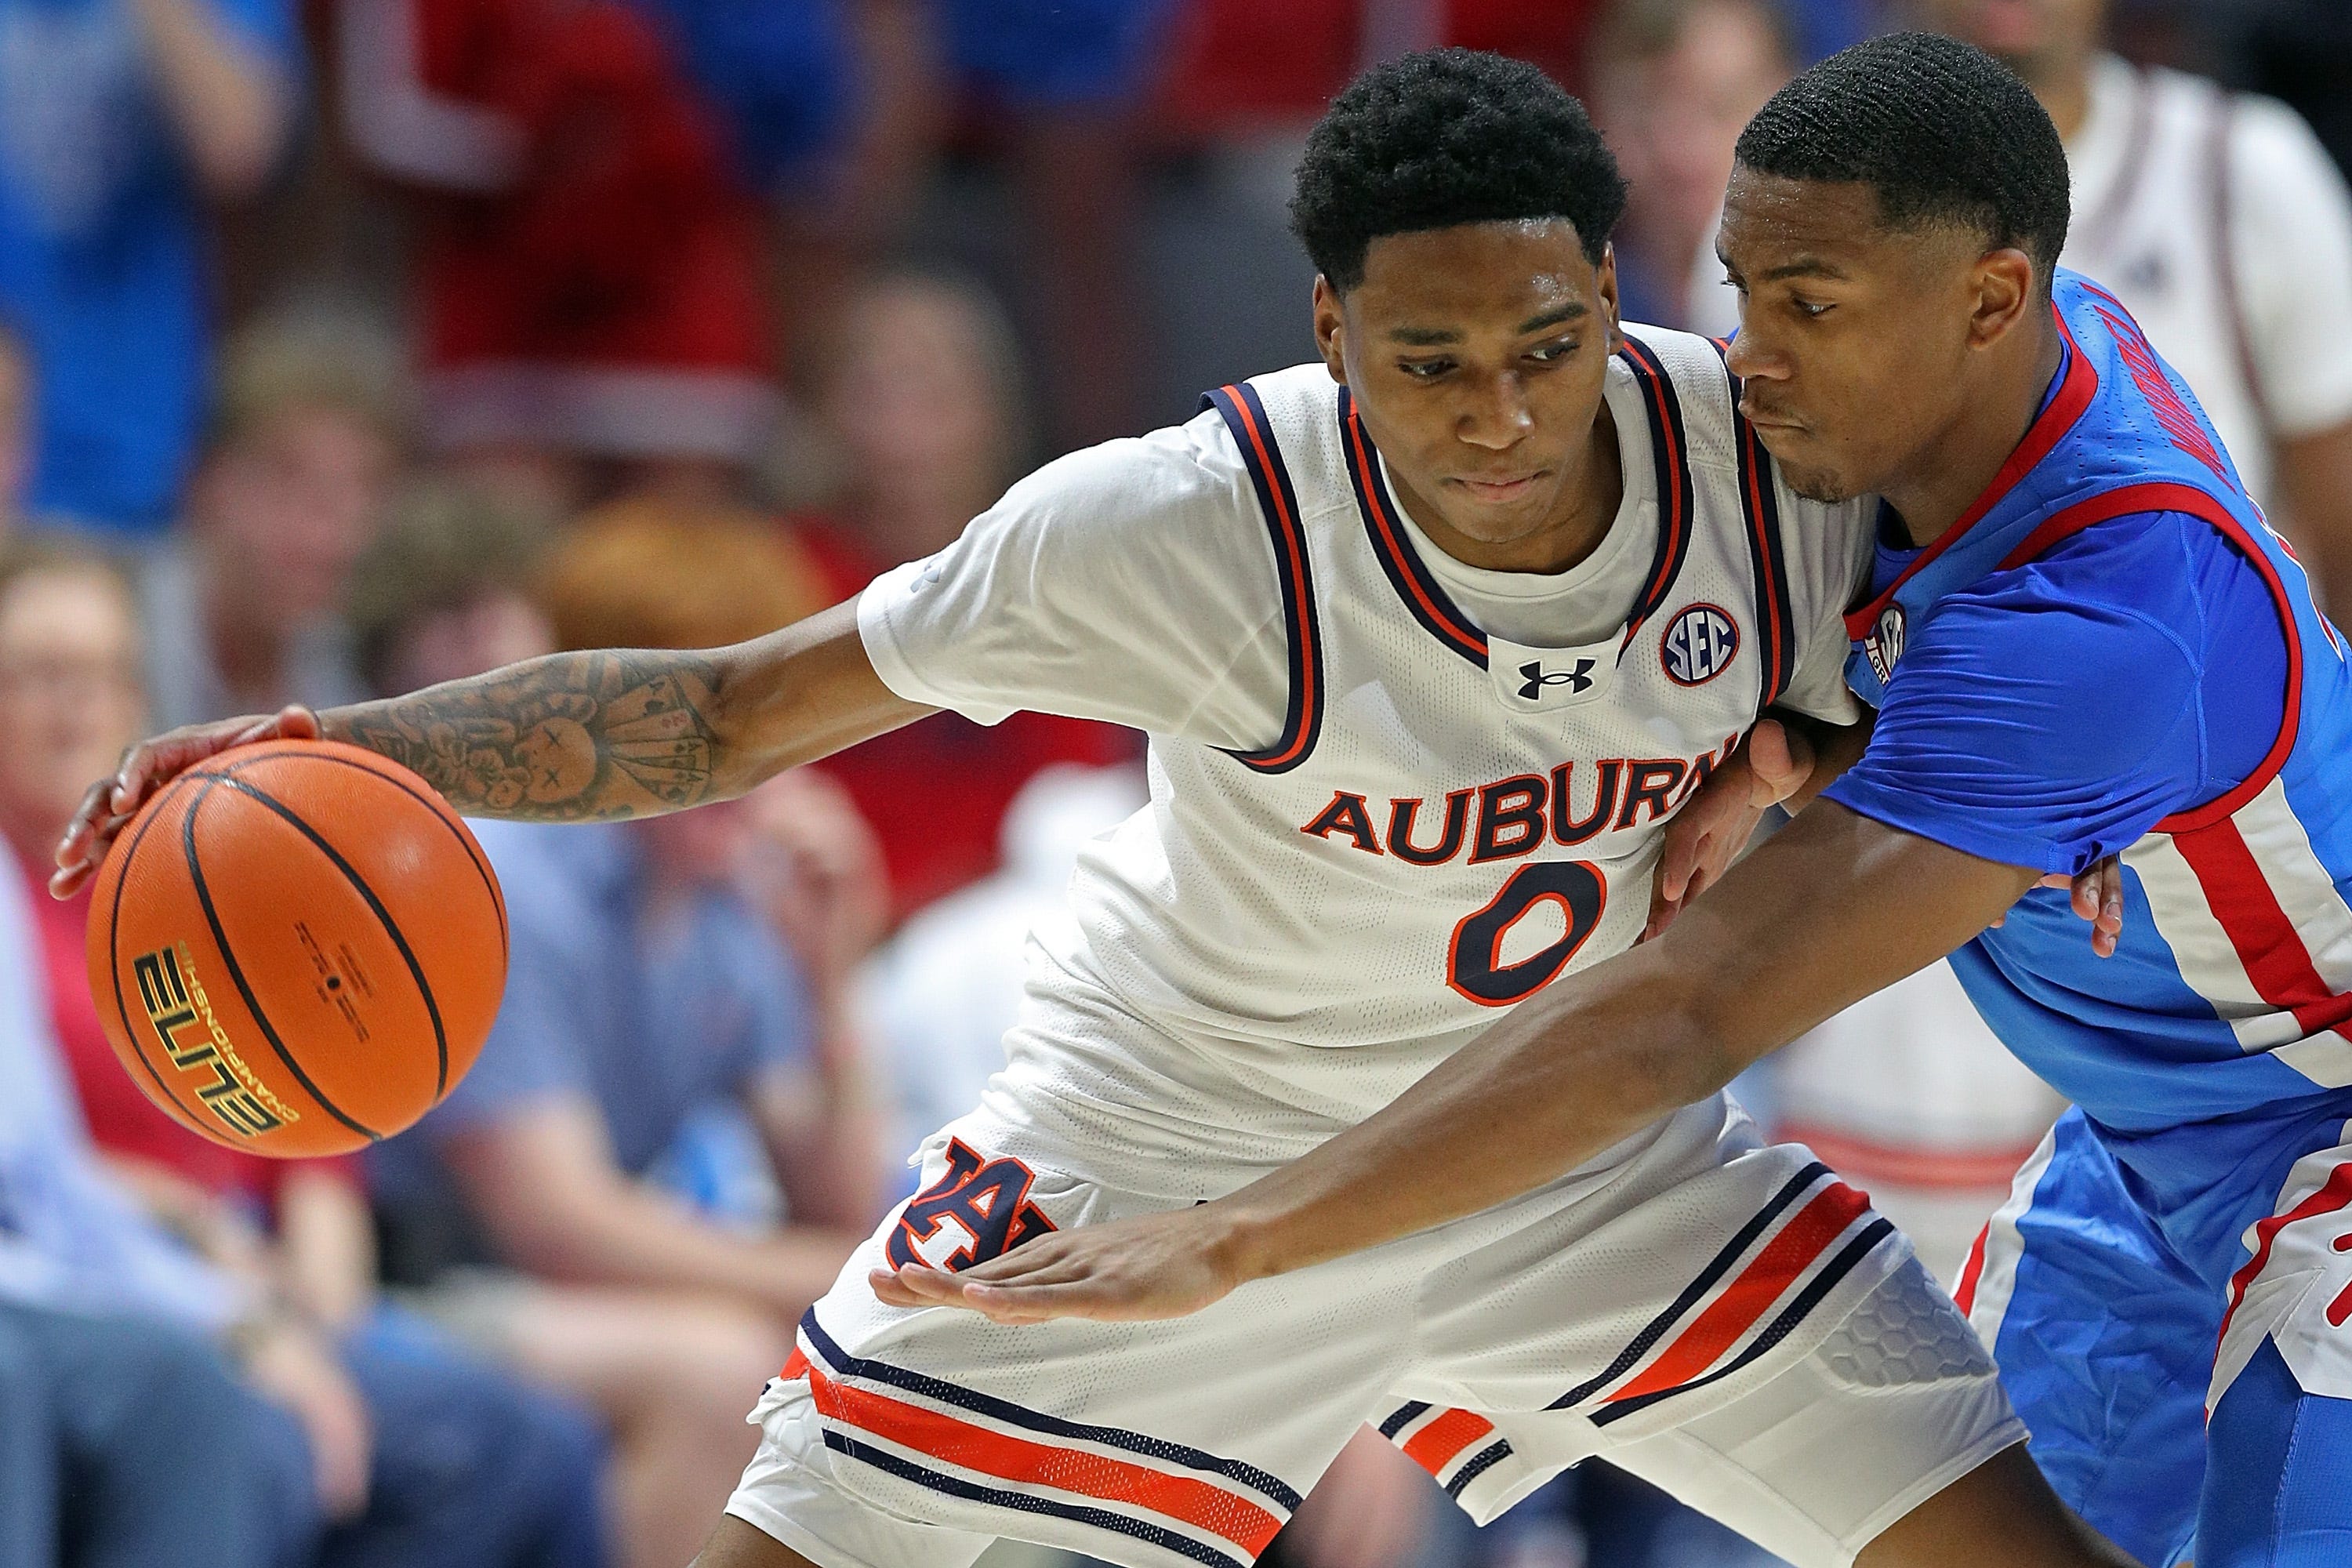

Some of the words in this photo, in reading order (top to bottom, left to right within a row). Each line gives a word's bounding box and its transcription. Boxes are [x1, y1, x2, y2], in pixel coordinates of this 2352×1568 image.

[1666, 611, 1732, 681] SEC
[1446, 860, 1607, 1008] 0
[132, 946, 285, 1138] ELITE
[177, 939, 302, 1123] CHAMPIONSHIP
